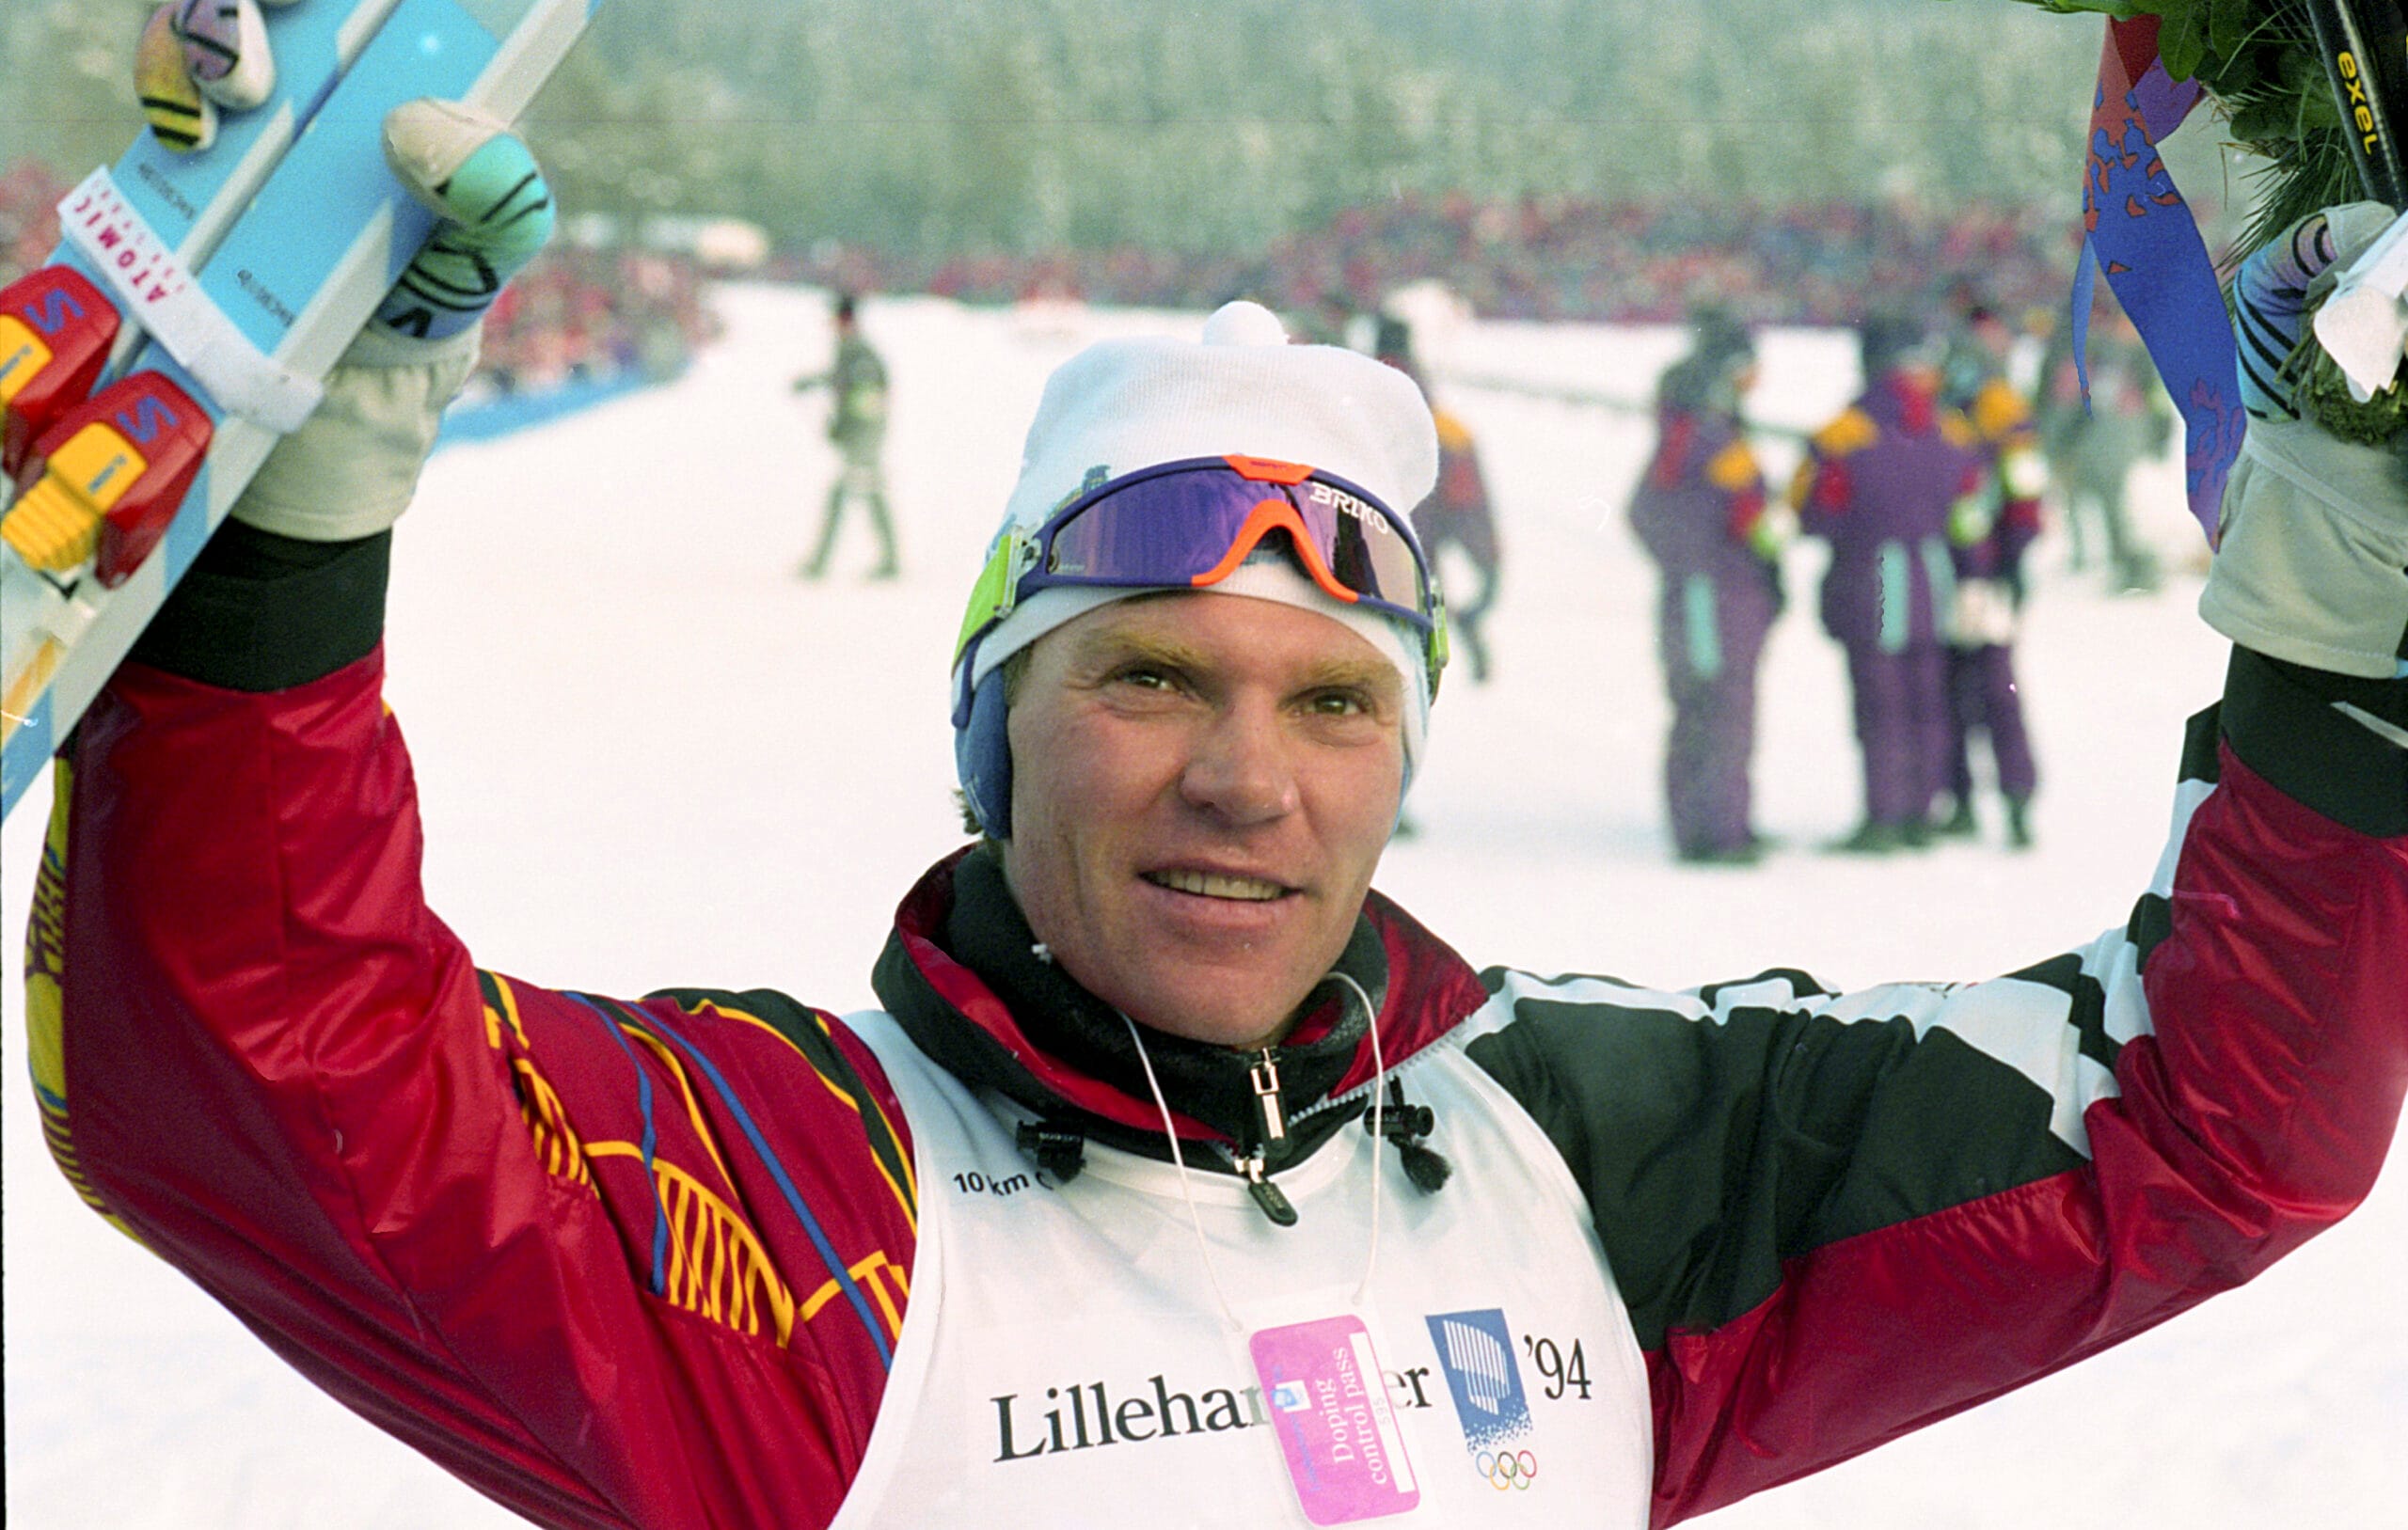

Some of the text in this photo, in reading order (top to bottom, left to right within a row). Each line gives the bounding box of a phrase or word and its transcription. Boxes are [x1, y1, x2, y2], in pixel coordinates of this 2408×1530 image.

[74, 196, 167, 303] ATOMIC
[1308, 481, 1389, 534] BRIKO
[953, 1171, 985, 1193] 10
[986, 1173, 1030, 1196] km
[990, 1366, 1433, 1463] Lillehaer
[1315, 1378, 1354, 1463] Doping
[1334, 1347, 1387, 1485] control pass
